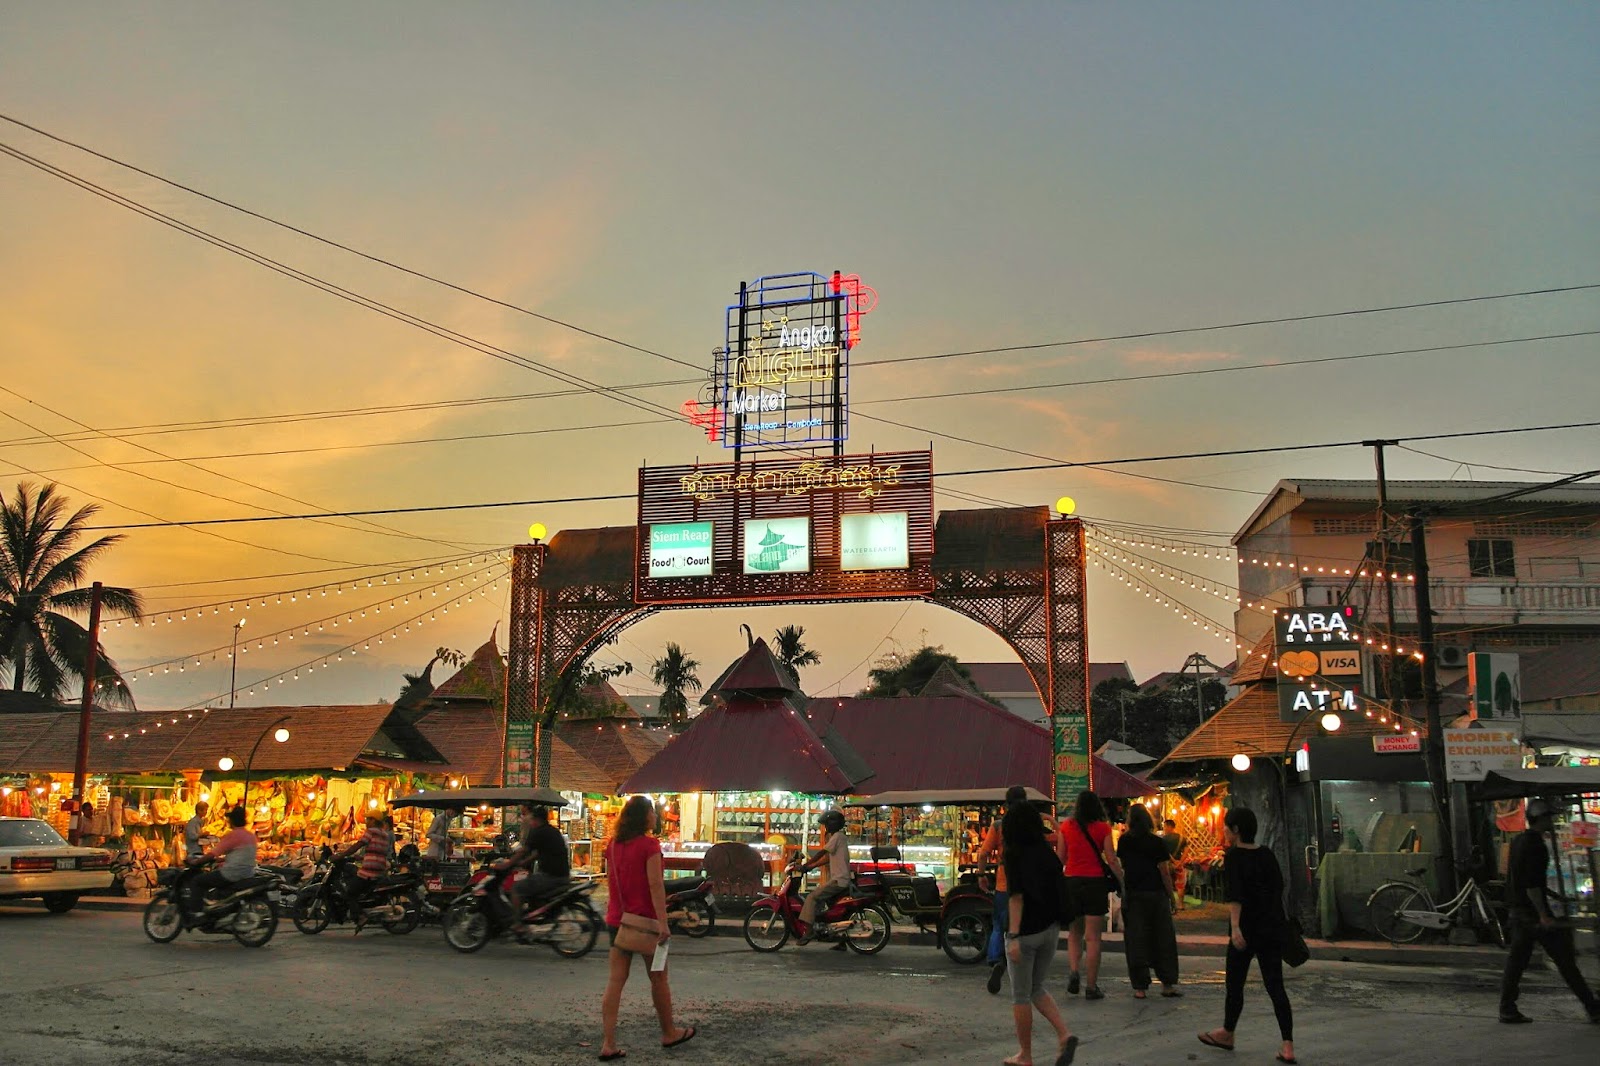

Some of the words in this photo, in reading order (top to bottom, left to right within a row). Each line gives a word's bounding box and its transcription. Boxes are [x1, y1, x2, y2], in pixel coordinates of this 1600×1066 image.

[779, 324, 835, 350] Angkor
[733, 346, 839, 387] NIGHT
[731, 388, 786, 415] Market
[786, 418, 822, 429] Cambodia
[653, 530, 680, 543] Siem
[682, 529, 710, 543] Reap
[651, 557, 672, 567] Food
[686, 556, 710, 566] Court
[1288, 612, 1349, 633] ABA
[1286, 632, 1350, 643] BANK
[1326, 658, 1357, 668] VISA
[1293, 690, 1355, 711] ATM
[1447, 732, 1514, 743] MONEY
[1377, 743, 1419, 751] EXCHANGE
[1448, 745, 1518, 756] EXCHANGE
